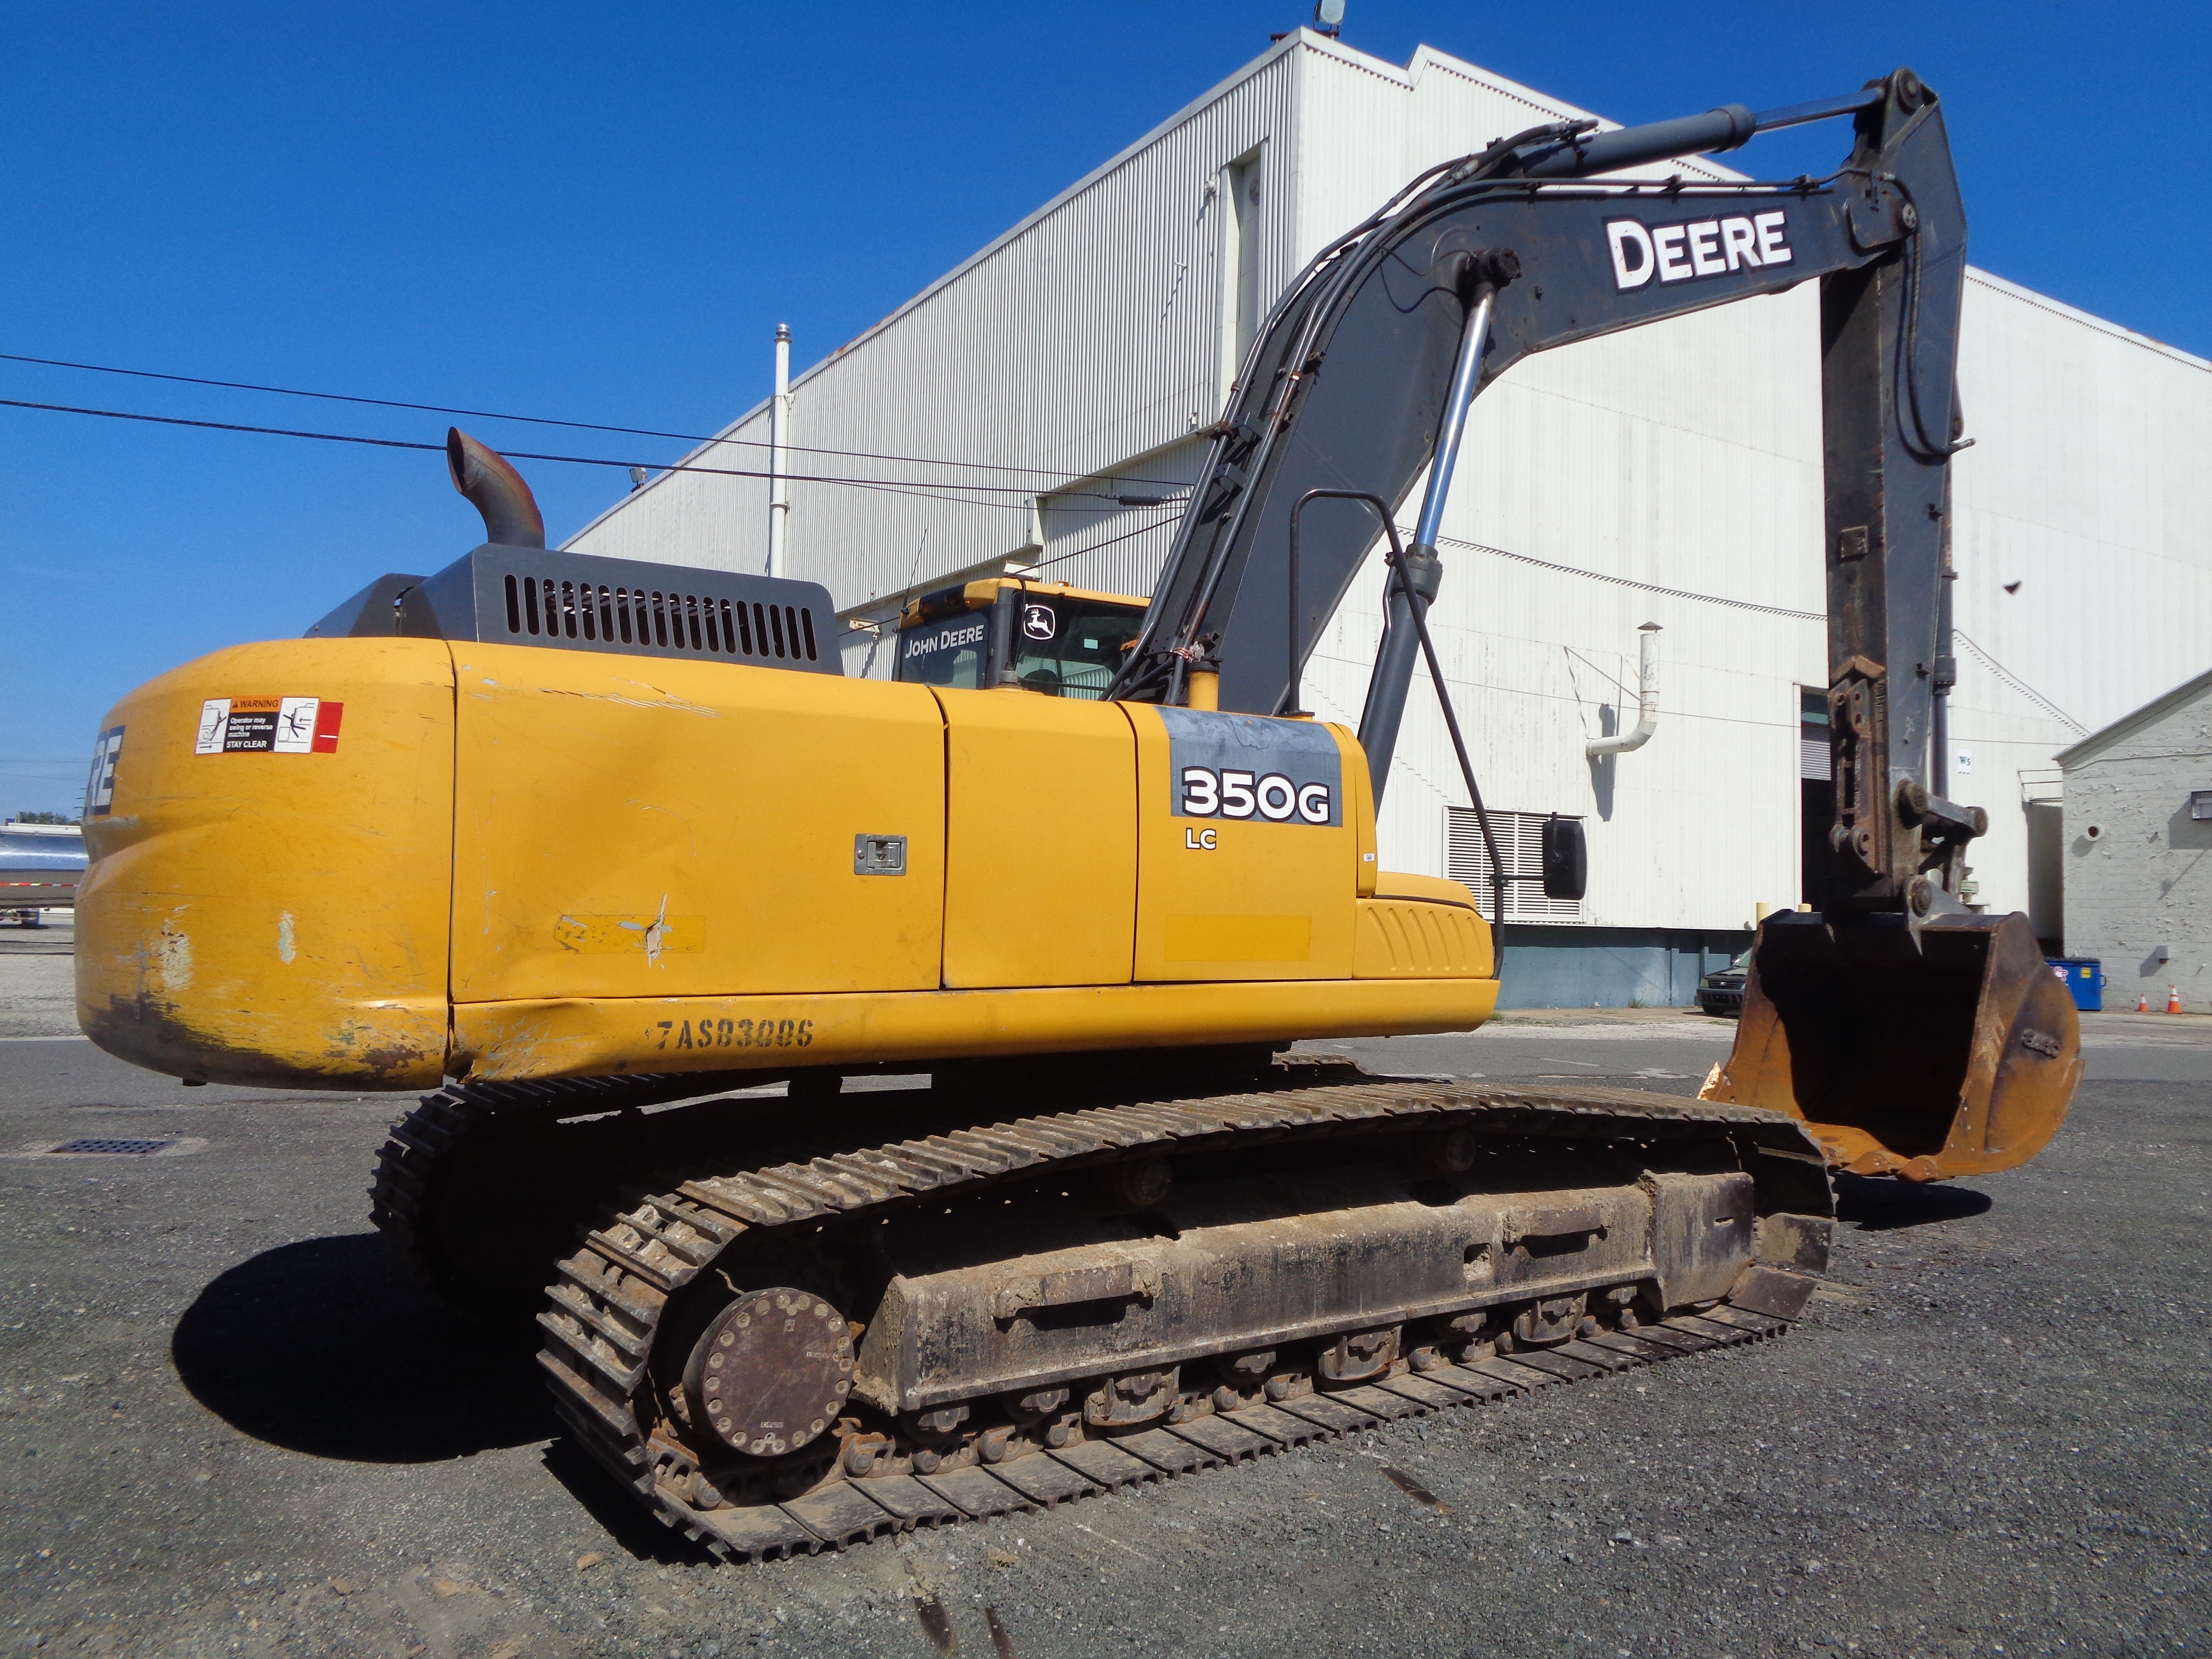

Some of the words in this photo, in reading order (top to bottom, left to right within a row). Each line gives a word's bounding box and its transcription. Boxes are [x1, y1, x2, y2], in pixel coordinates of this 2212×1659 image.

[1606, 211, 1792, 289] DEERE
[905, 636, 938, 659] JOHN
[940, 625, 984, 650] DEERE
[240, 699, 279, 708] WARNING
[1183, 766, 1330, 824] 350G
[1186, 828, 1216, 849] LC
